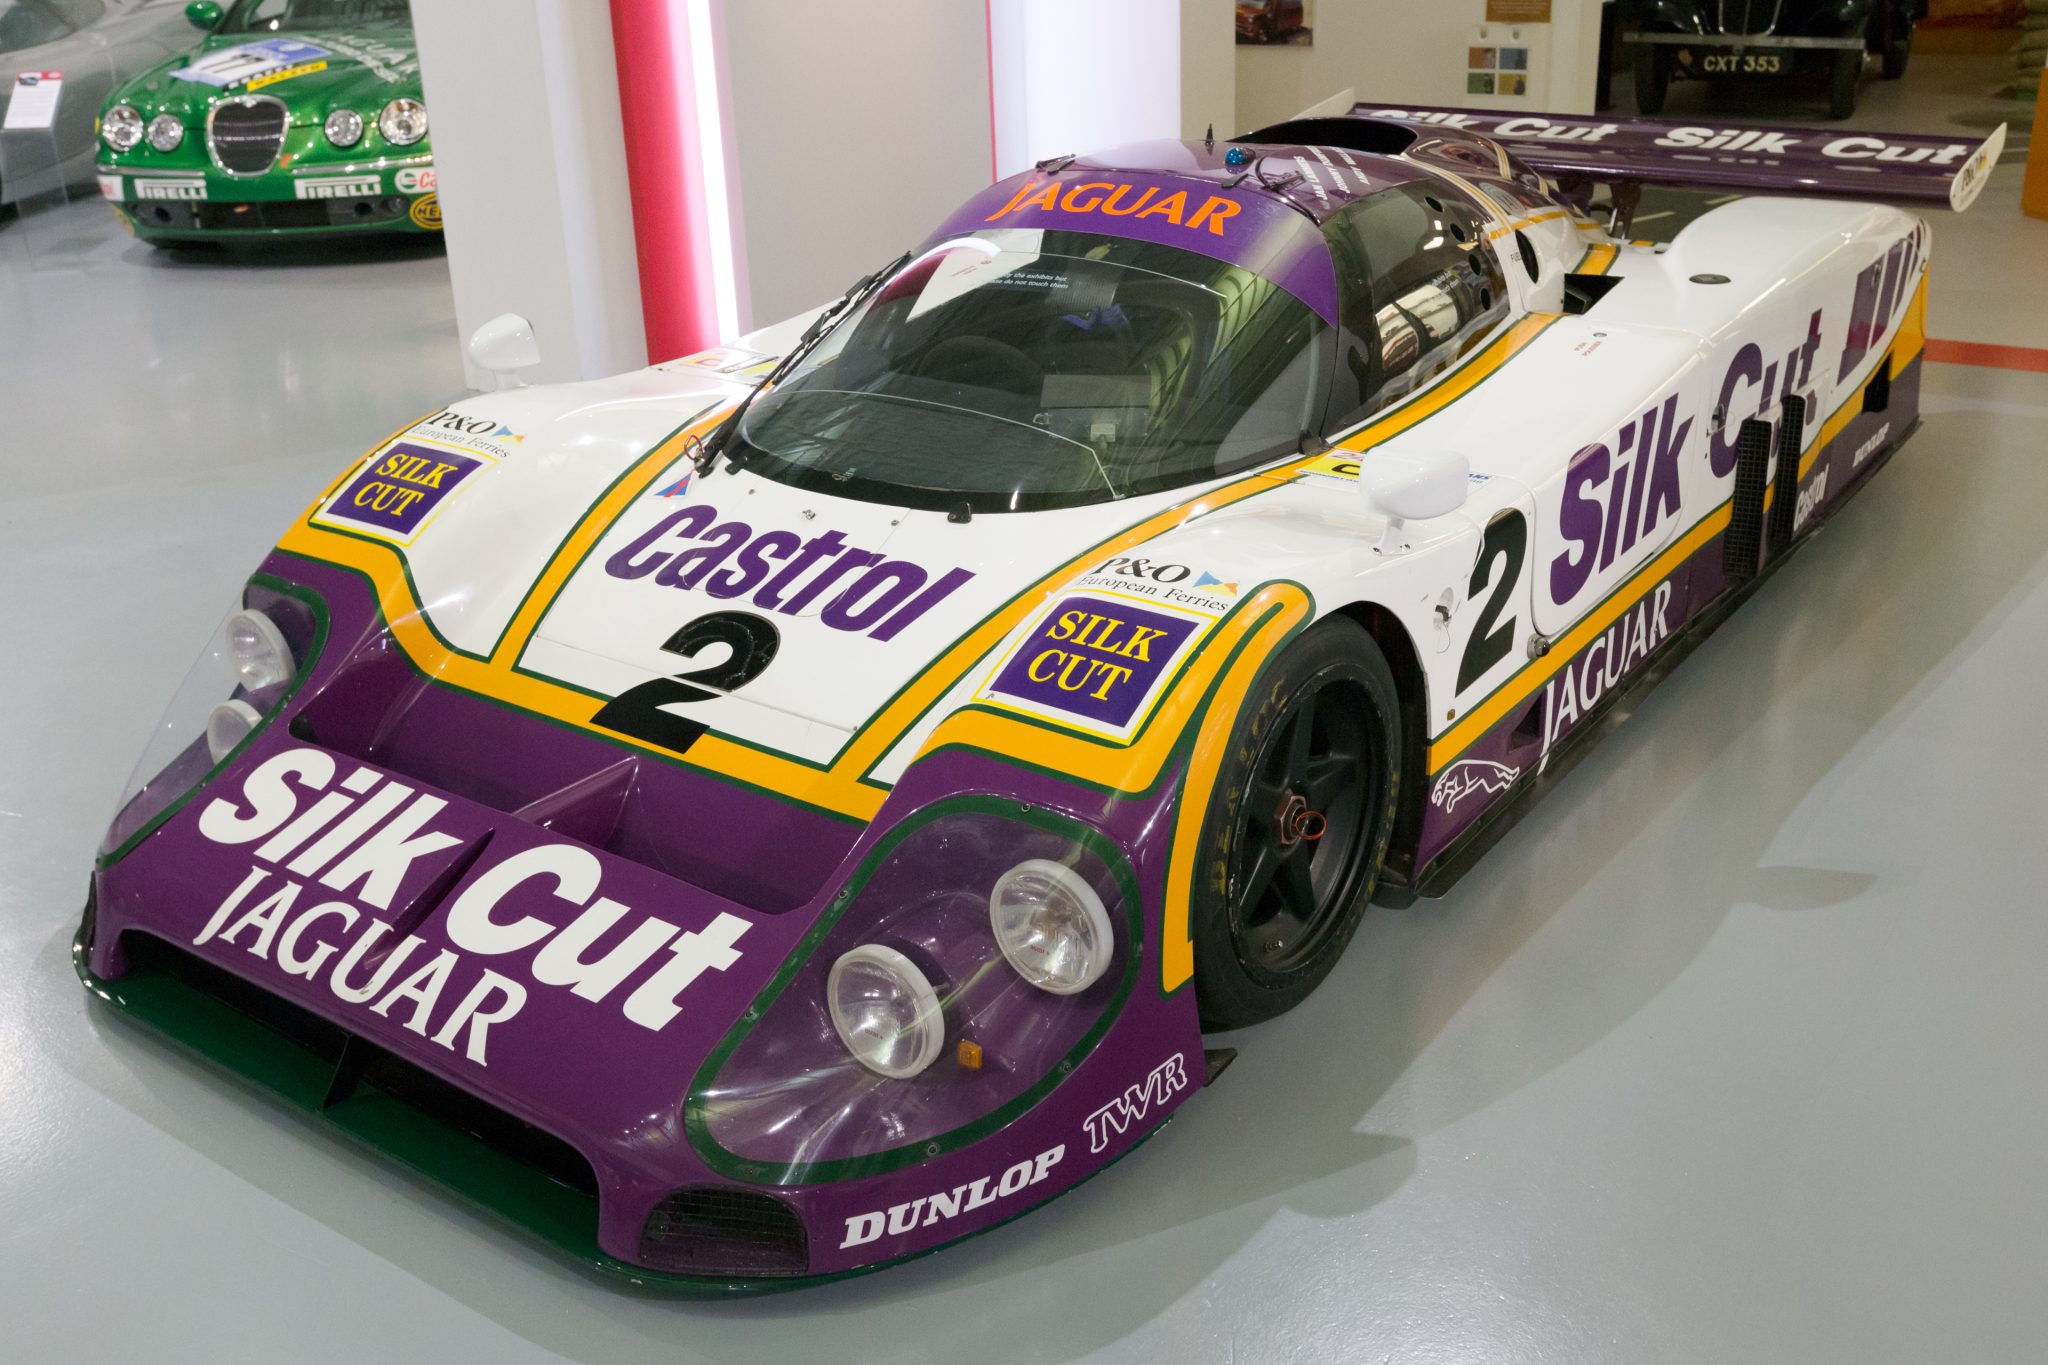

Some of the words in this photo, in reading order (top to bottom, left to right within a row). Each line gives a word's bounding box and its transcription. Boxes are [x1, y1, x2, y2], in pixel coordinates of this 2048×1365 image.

[1703, 55, 1740, 73] CXT
[1744, 56, 1781, 73] 353
[1494, 118, 1618, 141] Cut
[1654, 127, 1803, 155] Silk
[1821, 137, 1968, 165] Cut
[134, 178, 208, 200] PIRELLI
[294, 174, 382, 200] PIRELLI
[984, 182, 1243, 236] JAGUAR
[412, 425, 465, 444] European
[470, 437, 510, 459] Ferries
[427, 412, 497, 434] P&O
[374, 453, 458, 489] SILK
[354, 481, 425, 517] CUT
[1550, 392, 1695, 606] Silk
[605, 504, 977, 642] Castrol
[1079, 575, 1158, 596] European
[1163, 589, 1229, 612] Ferries
[1091, 557, 1191, 583] P&O
[1455, 507, 1528, 698] 2
[1045, 610, 1168, 662] SILK
[589, 610, 781, 754] 2
[1027, 649, 1133, 701] CUT
[1537, 580, 1672, 776] JAGUAR
[198, 747, 464, 910] Silk
[446, 844, 754, 1032] Cut
[193, 866, 528, 1067] JAGUAR
[1083, 1052, 1188, 1154] TWR
[839, 1144, 1066, 1250] DUNLOP
